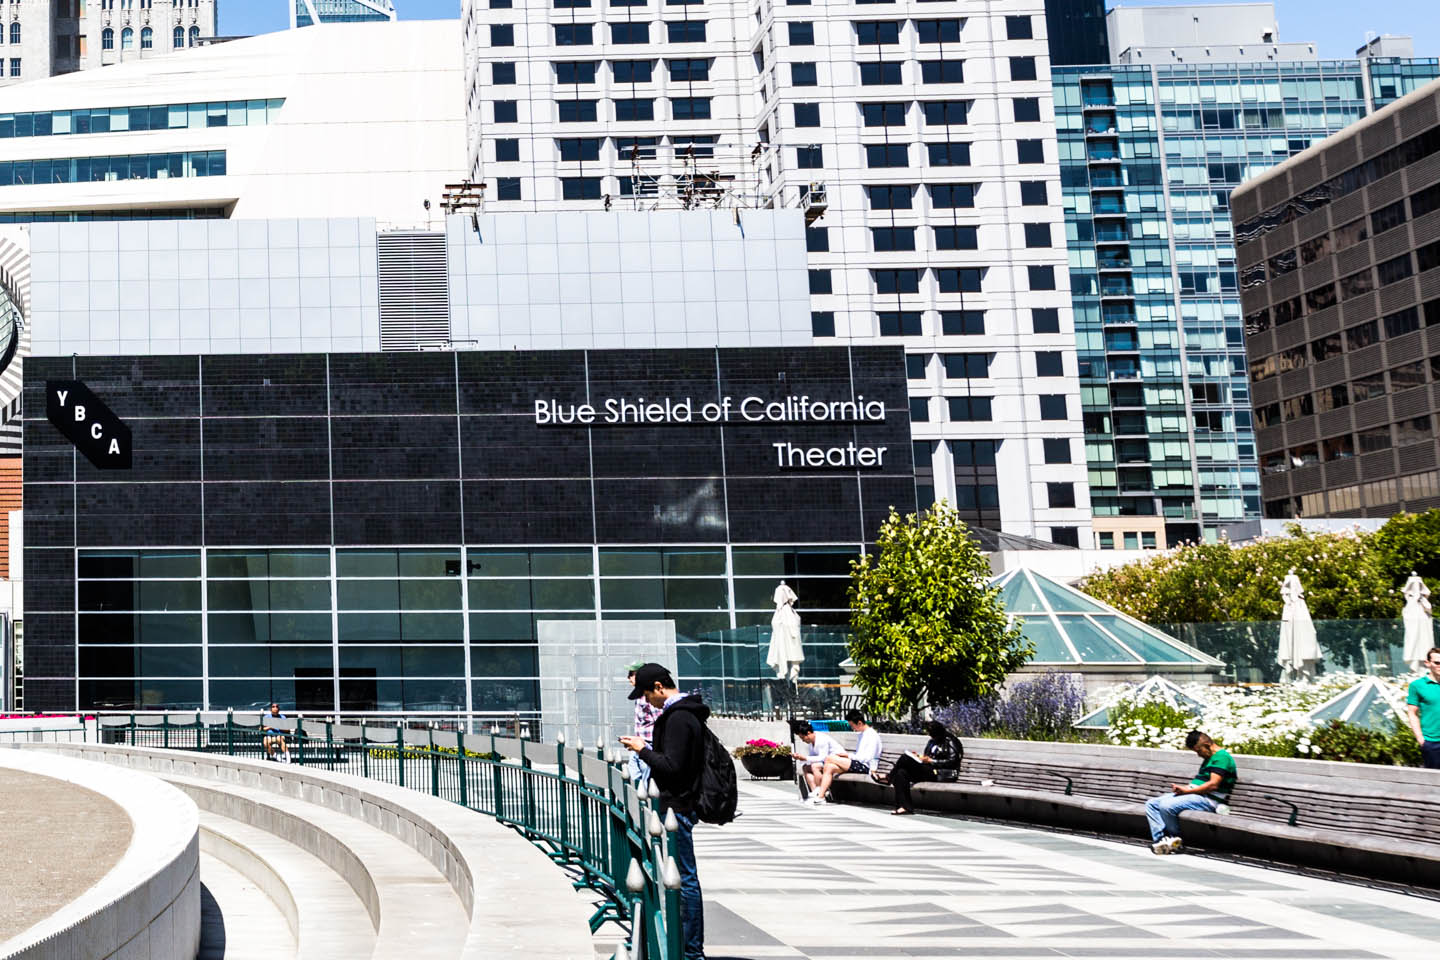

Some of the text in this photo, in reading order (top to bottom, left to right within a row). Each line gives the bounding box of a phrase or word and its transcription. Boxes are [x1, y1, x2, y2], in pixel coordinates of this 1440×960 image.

[534, 395, 885, 424] Blue Shield of California
[772, 441, 888, 467] Theater
